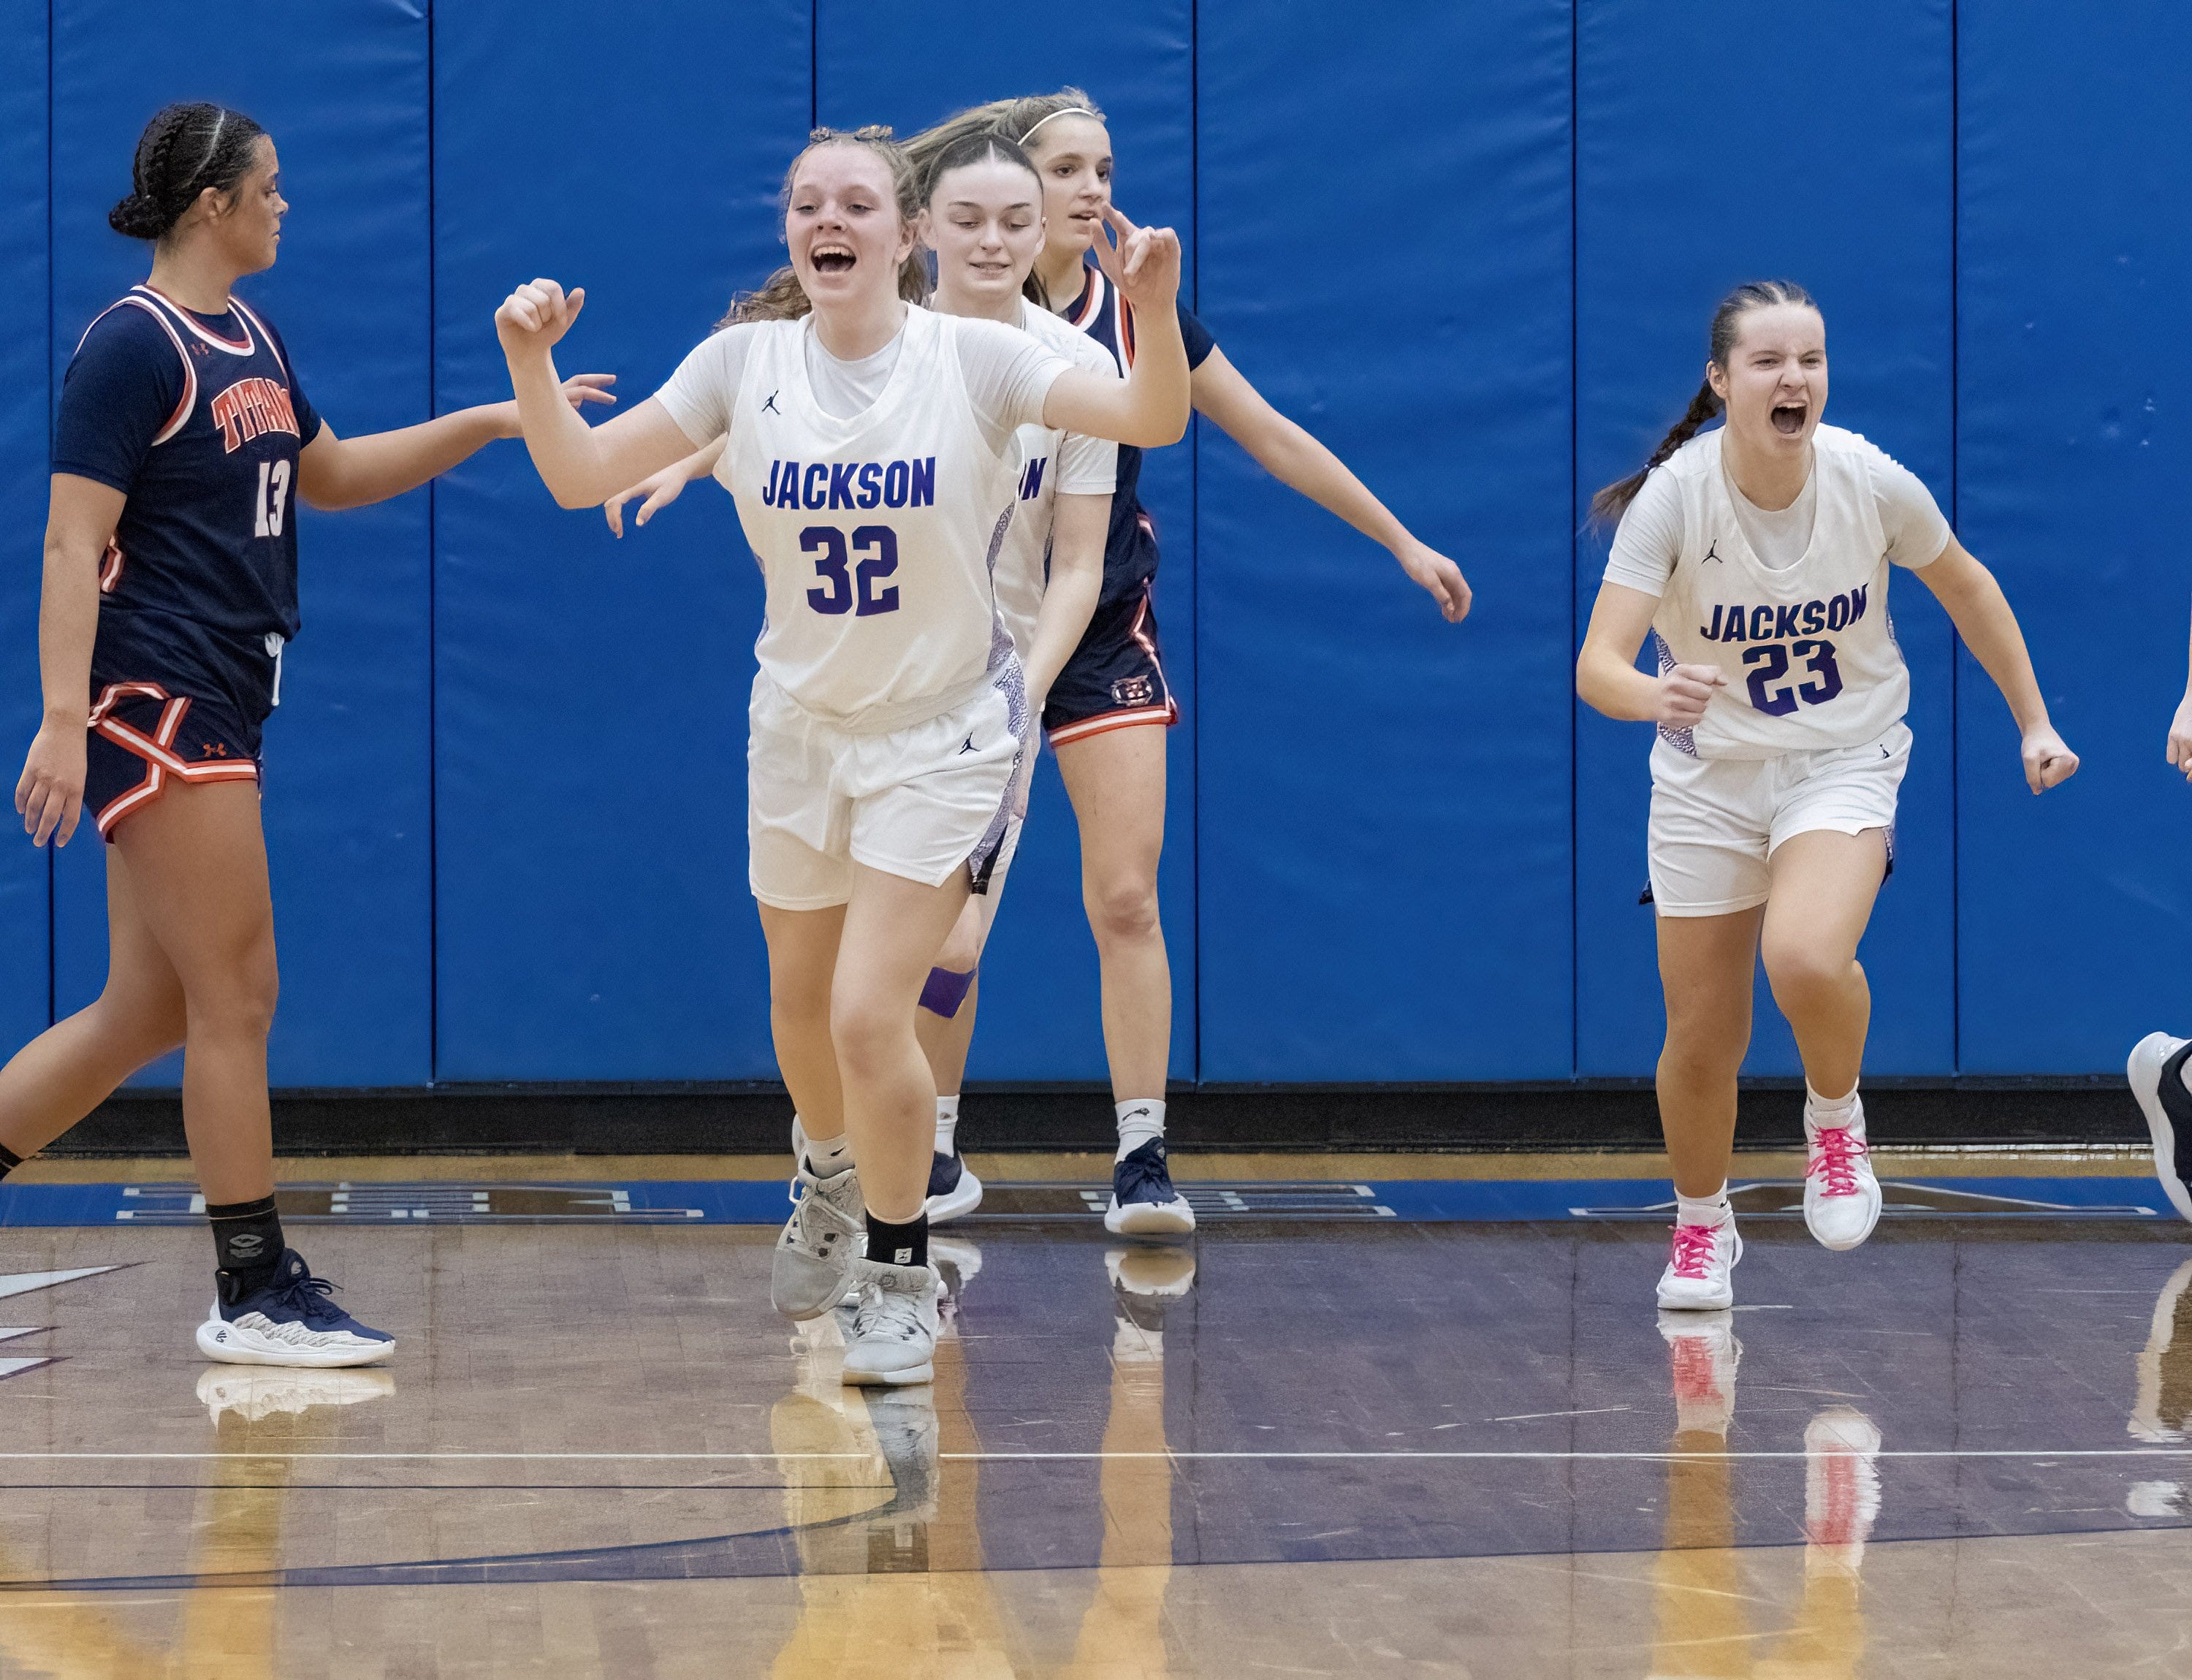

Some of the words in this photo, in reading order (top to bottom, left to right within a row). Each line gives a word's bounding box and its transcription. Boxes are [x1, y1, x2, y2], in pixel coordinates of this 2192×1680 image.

[255, 459, 291, 538] 13
[763, 457, 935, 510] JACKSON
[799, 525, 899, 616] 32
[1700, 583, 1868, 642] JACKSON
[1742, 640, 1843, 716] 23
